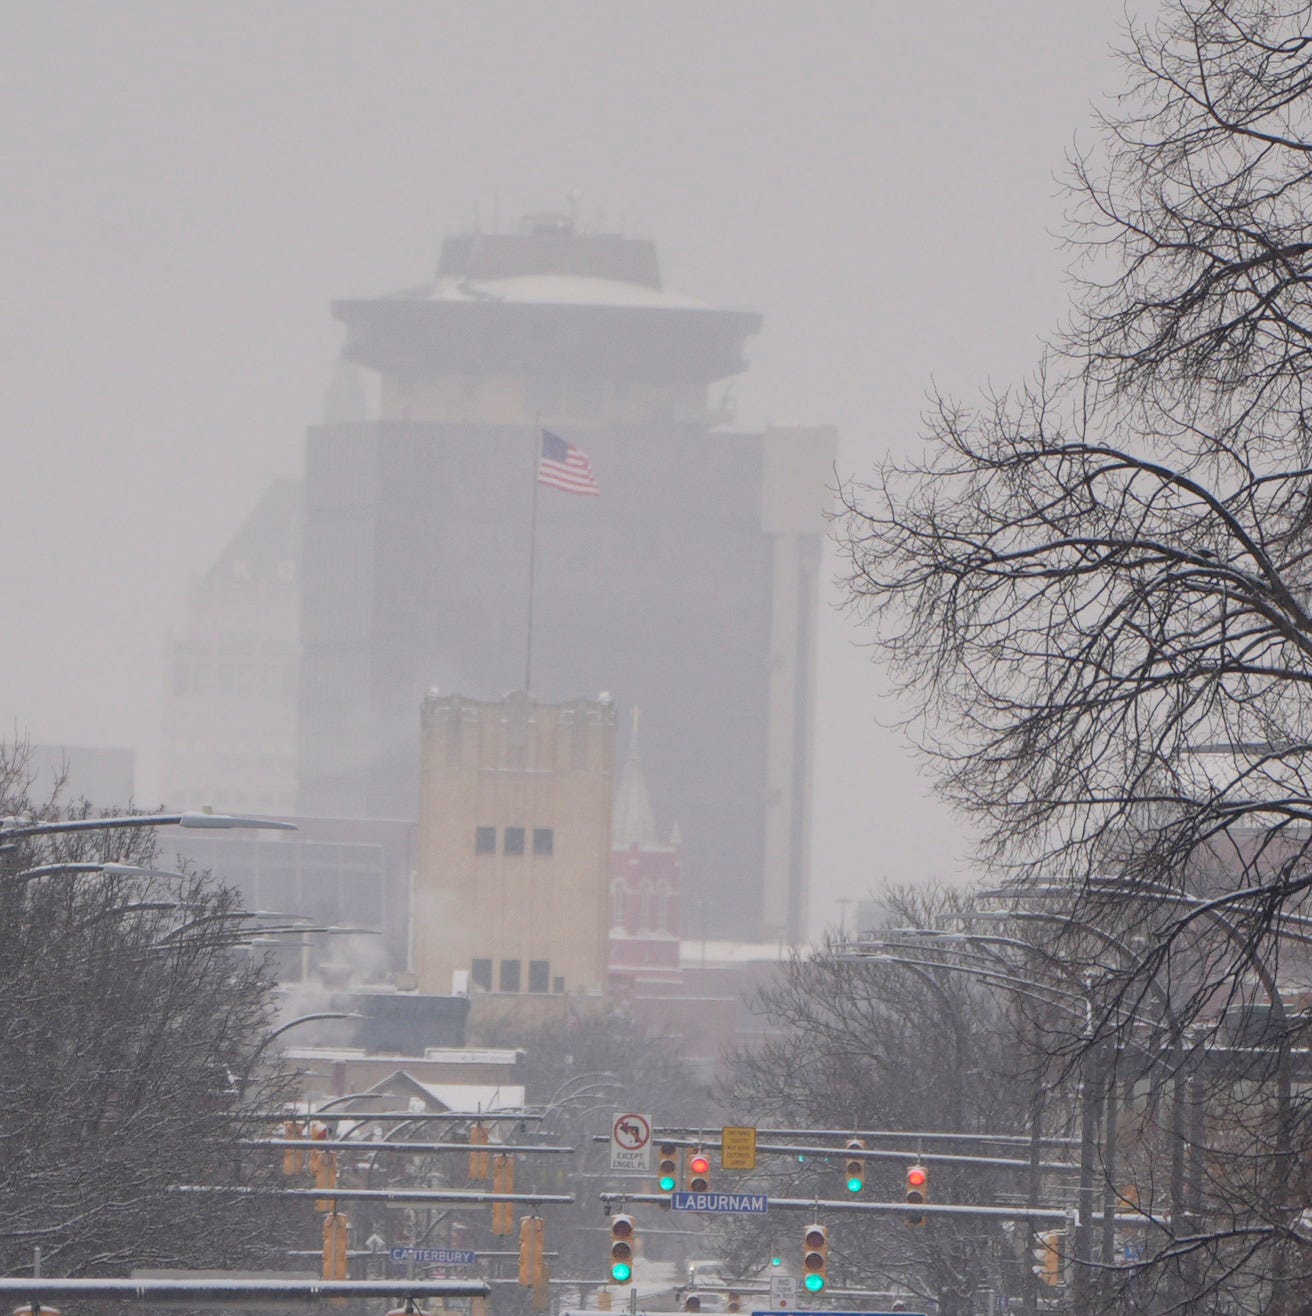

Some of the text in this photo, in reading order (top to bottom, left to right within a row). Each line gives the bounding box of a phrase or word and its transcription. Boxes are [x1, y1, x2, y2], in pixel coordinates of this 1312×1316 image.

[616, 1152, 644, 1160] EXCEPT
[612, 1160, 636, 1168] ENGEL
[675, 1195, 764, 1212] LABURNAM
